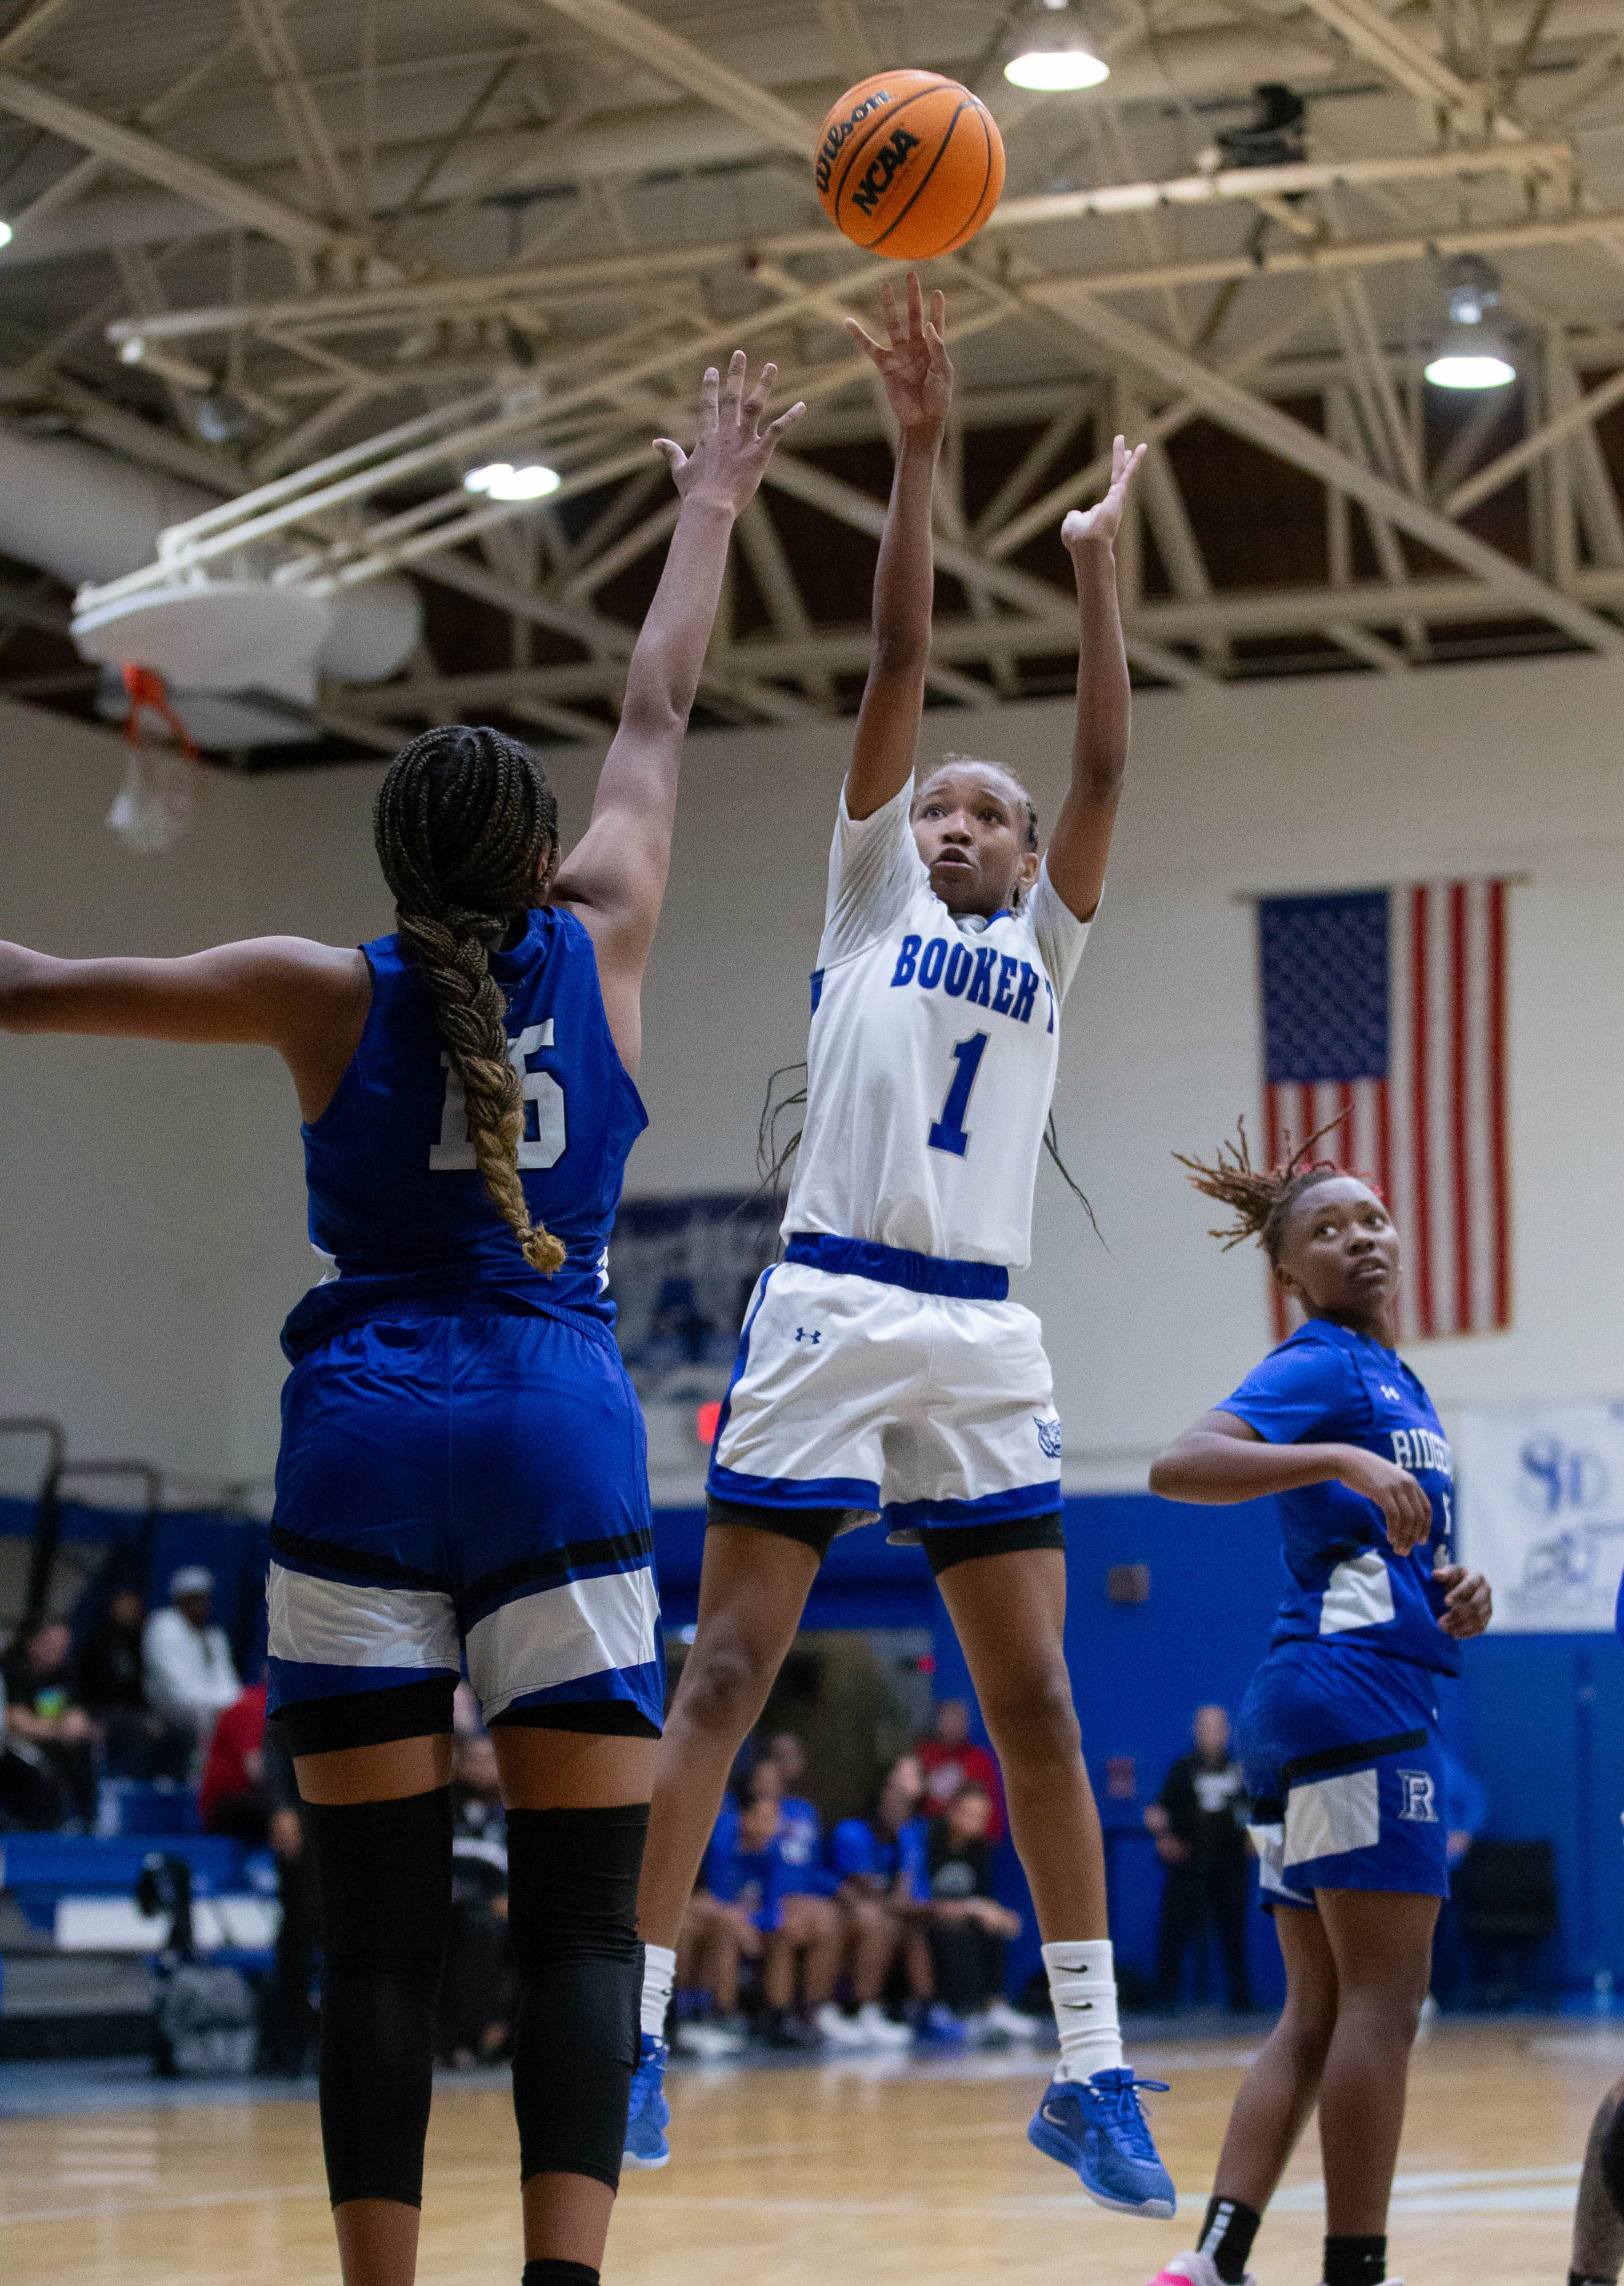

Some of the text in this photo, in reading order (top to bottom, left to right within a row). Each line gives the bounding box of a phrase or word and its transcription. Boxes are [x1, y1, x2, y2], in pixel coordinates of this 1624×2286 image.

[816, 90, 890, 193] Wilson
[852, 127, 919, 217] NCAA
[890, 935, 1039, 1024] BOOKER
[927, 1029, 992, 1159] 1
[1397, 1769, 1438, 1823] R
